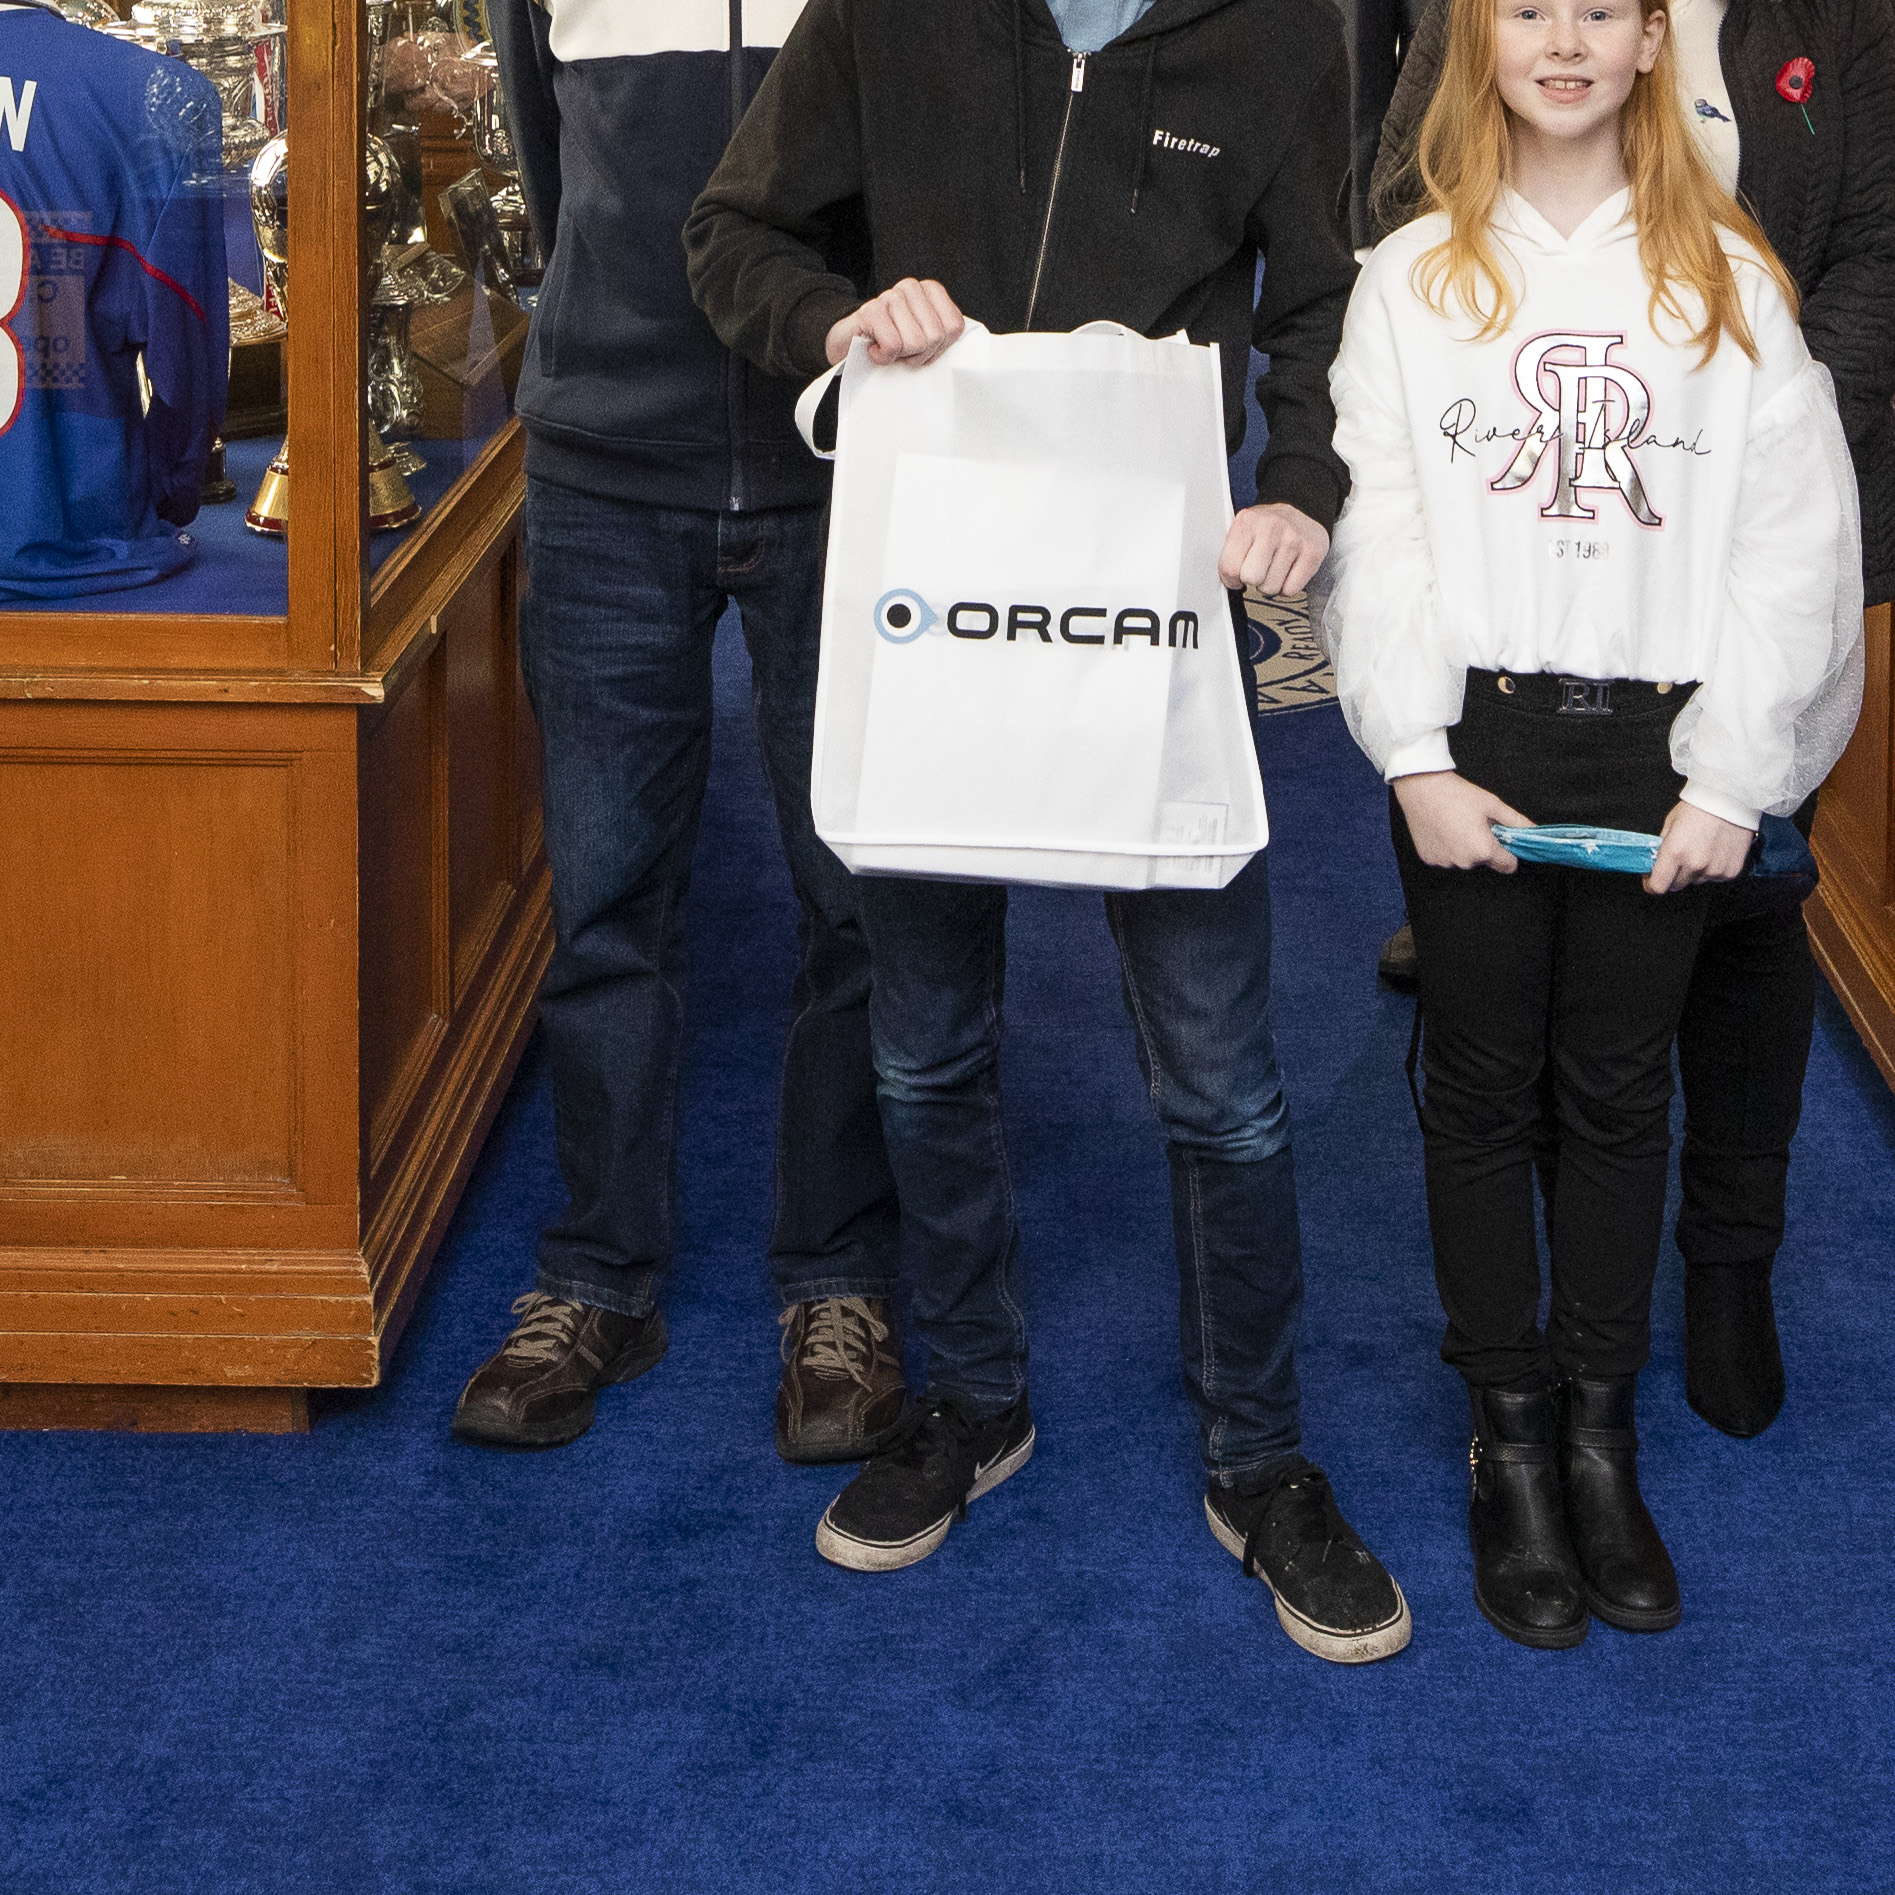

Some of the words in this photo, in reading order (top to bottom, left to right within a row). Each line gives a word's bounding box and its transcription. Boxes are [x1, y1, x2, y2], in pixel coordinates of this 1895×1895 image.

[1152, 127, 1222, 160] Firetrap
[1439, 398, 1562, 464] River
[1578, 399, 1712, 455] Island
[946, 600, 1199, 650] ORCAM
